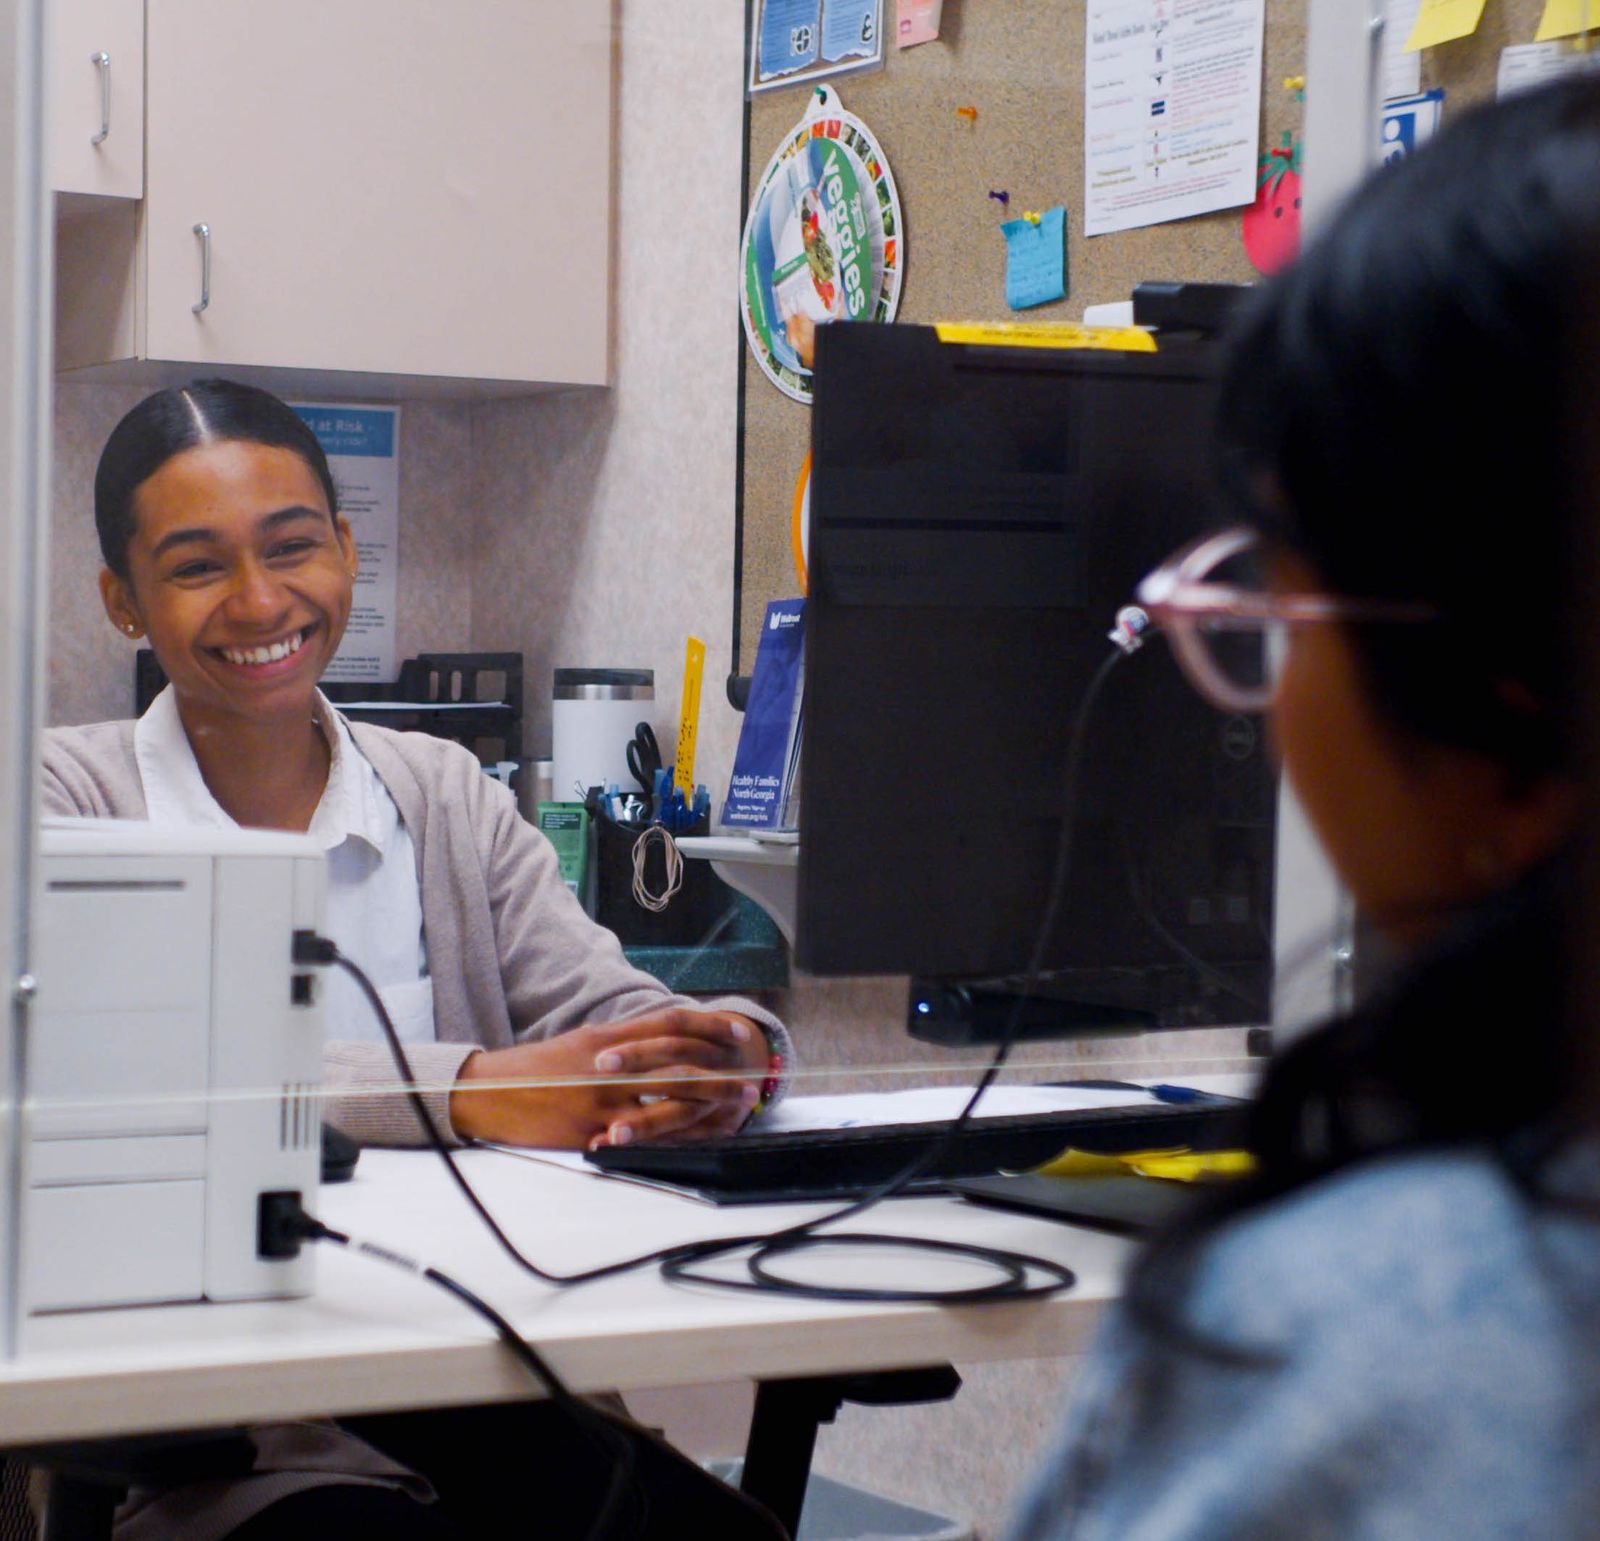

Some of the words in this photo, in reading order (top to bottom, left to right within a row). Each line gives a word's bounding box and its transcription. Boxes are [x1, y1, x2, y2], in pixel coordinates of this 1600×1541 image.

[822, 149, 865, 317] veggies
[732, 775, 753, 788] Healthy
[754, 775, 780, 787] Families
[733, 787, 750, 799] North
[751, 788, 775, 802] Georgia
